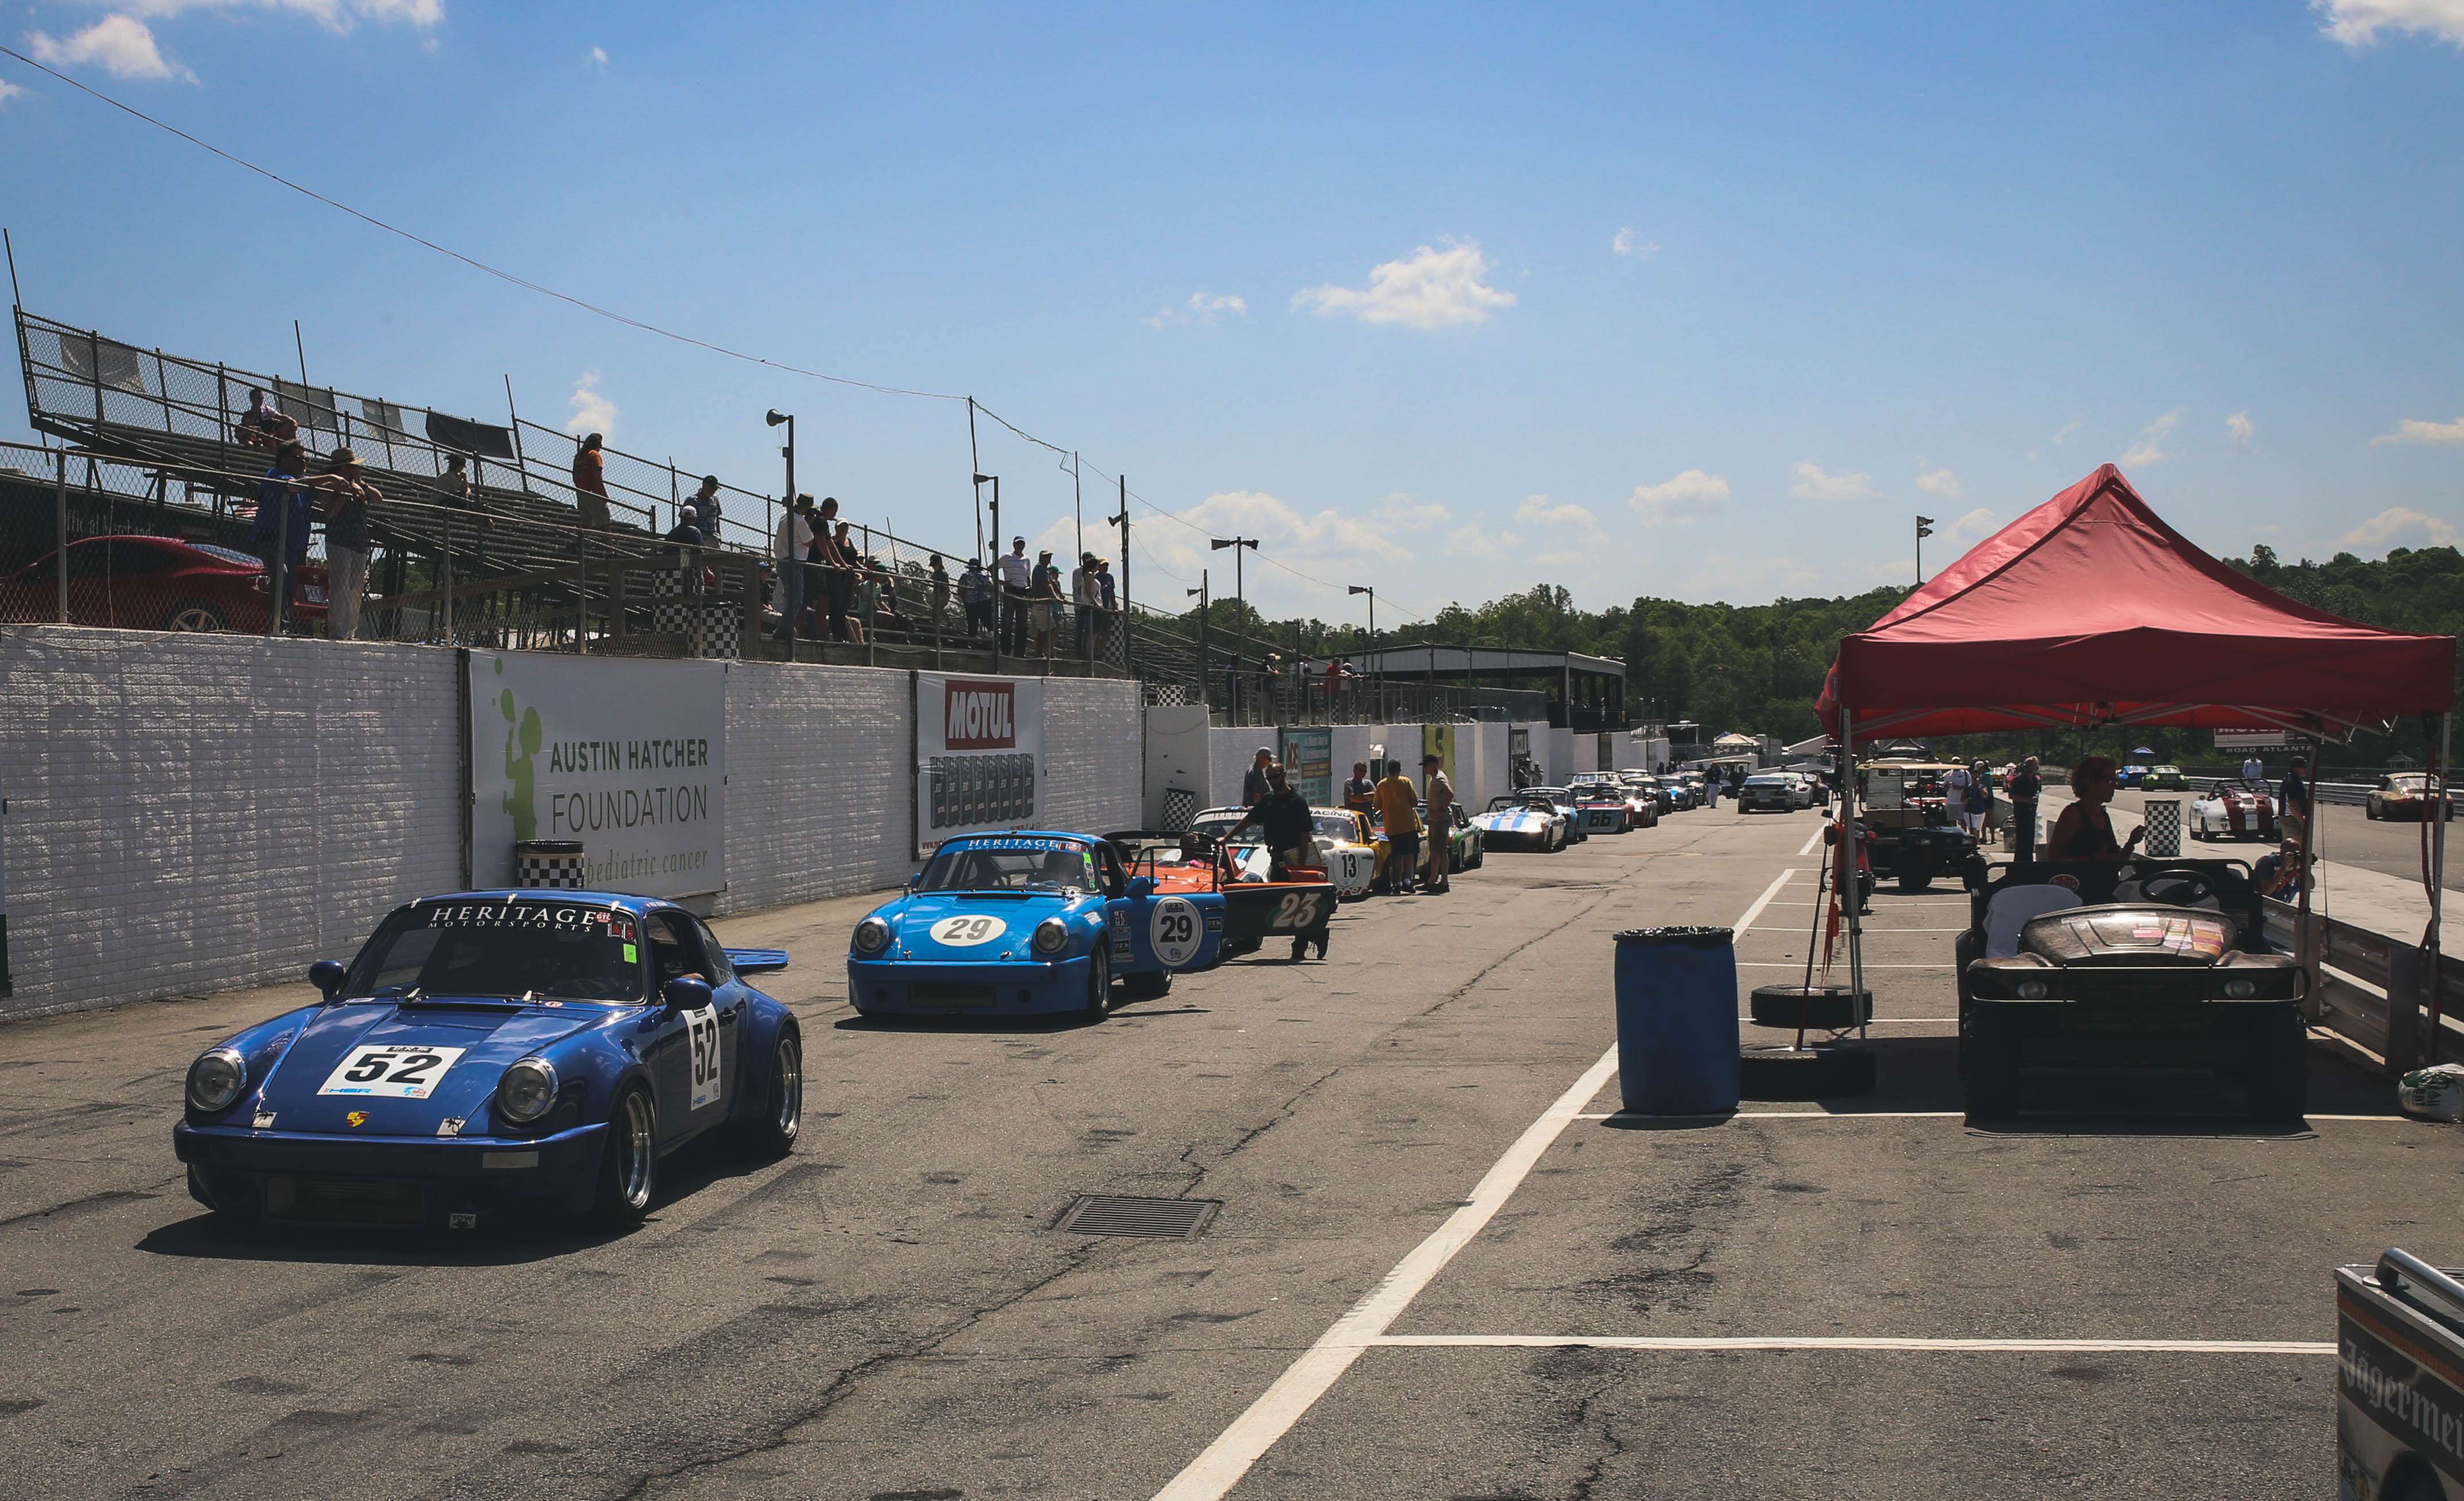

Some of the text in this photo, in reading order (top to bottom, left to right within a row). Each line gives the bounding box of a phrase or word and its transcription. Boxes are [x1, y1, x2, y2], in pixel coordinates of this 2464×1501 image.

[948, 691, 1012, 740] MOTUL
[550, 738, 708, 773] AUSTIN HATCHER
[552, 784, 707, 834] FOUNDATION
[1588, 810, 1612, 827] 66
[968, 838, 1058, 848] HERITAGE
[586, 848, 708, 888] pediatric cancer
[1341, 854, 1357, 878] 13
[431, 906, 597, 926] HERITAGE
[1272, 892, 1321, 928] 23
[427, 921, 593, 933] MOTORSPORTS
[943, 919, 992, 940] 29
[1159, 915, 1193, 943] 29
[692, 1018, 718, 1087] 52
[344, 1053, 443, 1084] 52
[453, 1214, 474, 1222] TOW
